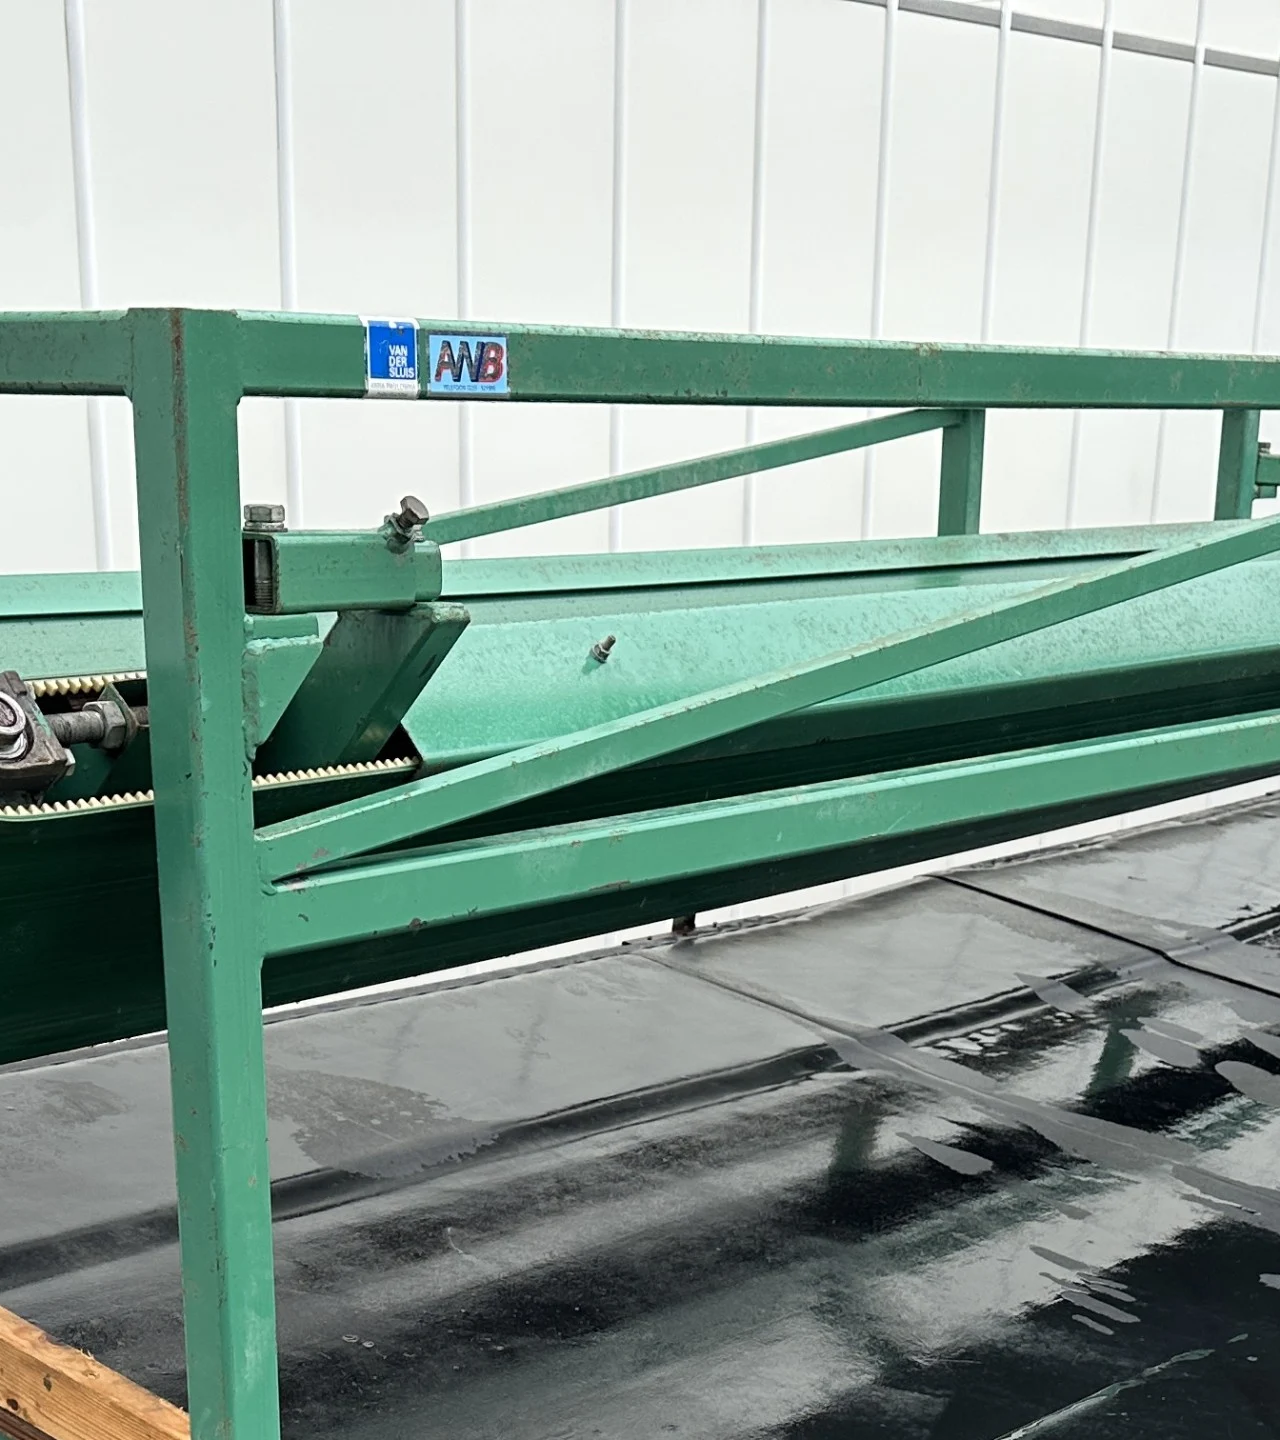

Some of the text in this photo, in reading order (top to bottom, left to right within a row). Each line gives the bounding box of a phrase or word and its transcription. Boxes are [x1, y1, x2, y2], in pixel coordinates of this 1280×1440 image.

[389, 345, 408, 356] VAN
[389, 356, 407, 367] DER
[389, 367, 415, 378] SLUIS
